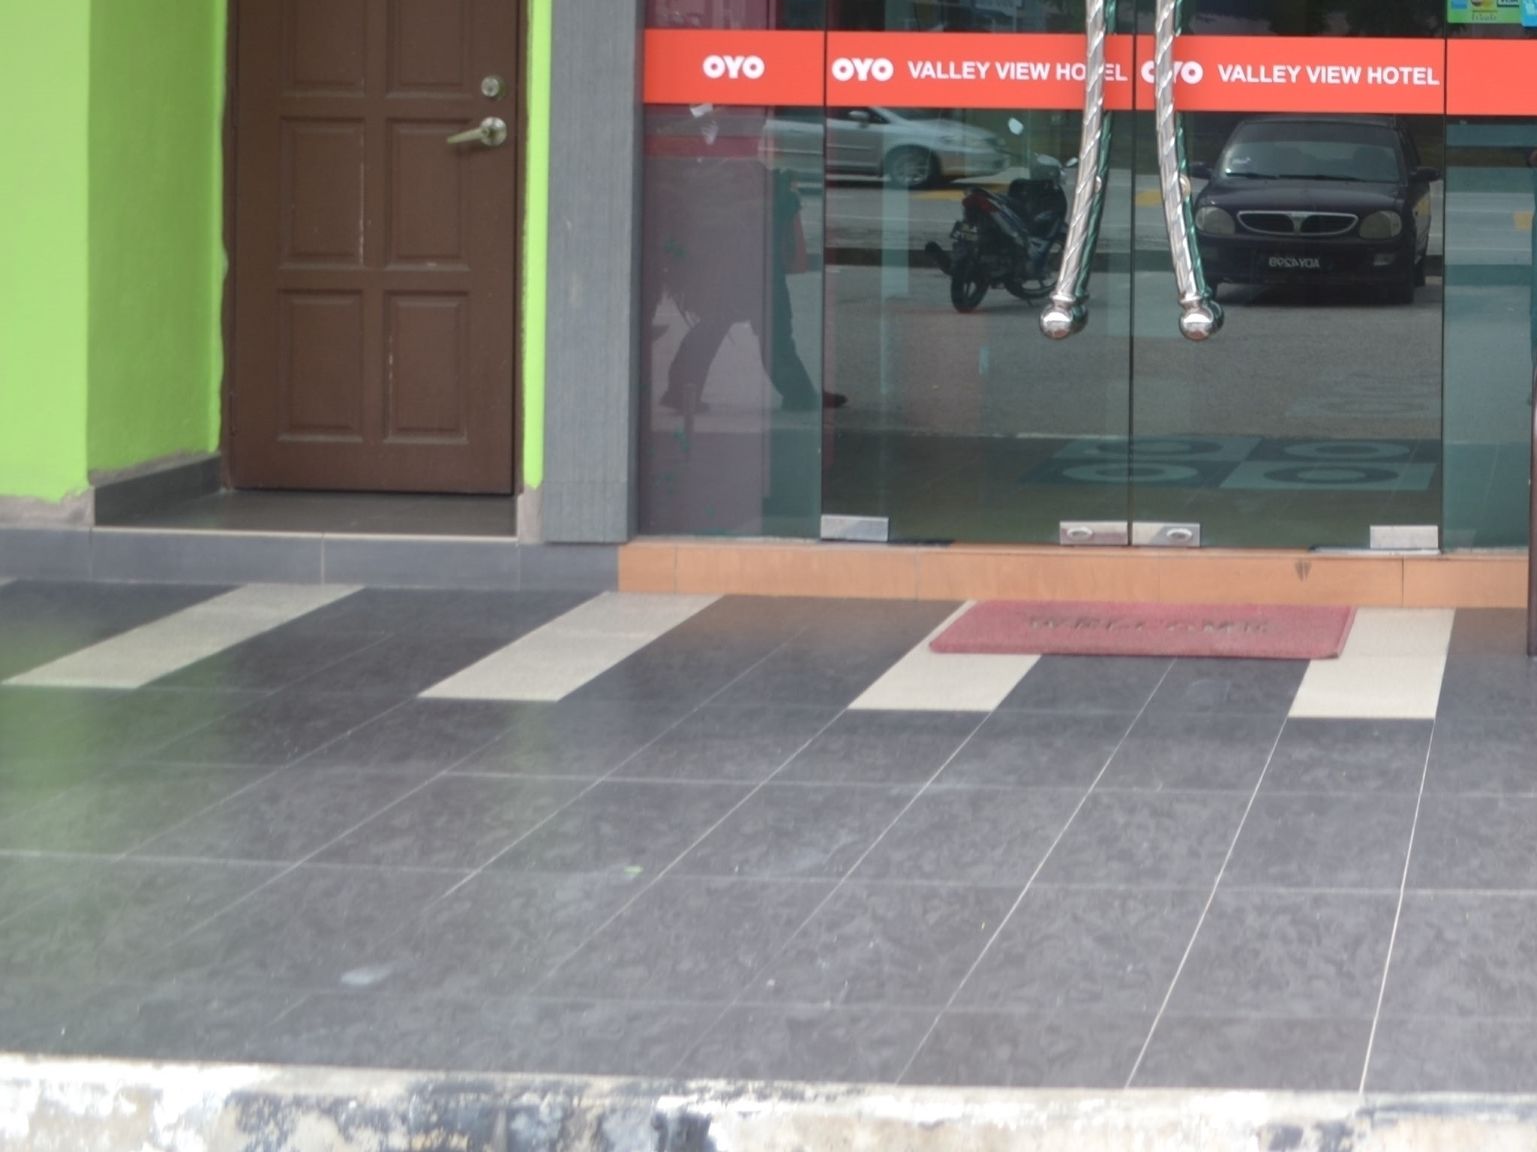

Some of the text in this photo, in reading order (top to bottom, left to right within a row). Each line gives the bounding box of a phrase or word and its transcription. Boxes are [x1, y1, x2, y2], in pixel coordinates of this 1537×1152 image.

[702, 55, 766, 79] OYO
[831, 57, 1128, 82] OYO VALLEY VIEW HOEL
[1217, 63, 1302, 84] VALLEY
[1305, 65, 1362, 85] VIEW
[1366, 66, 1441, 86] HOTEL
